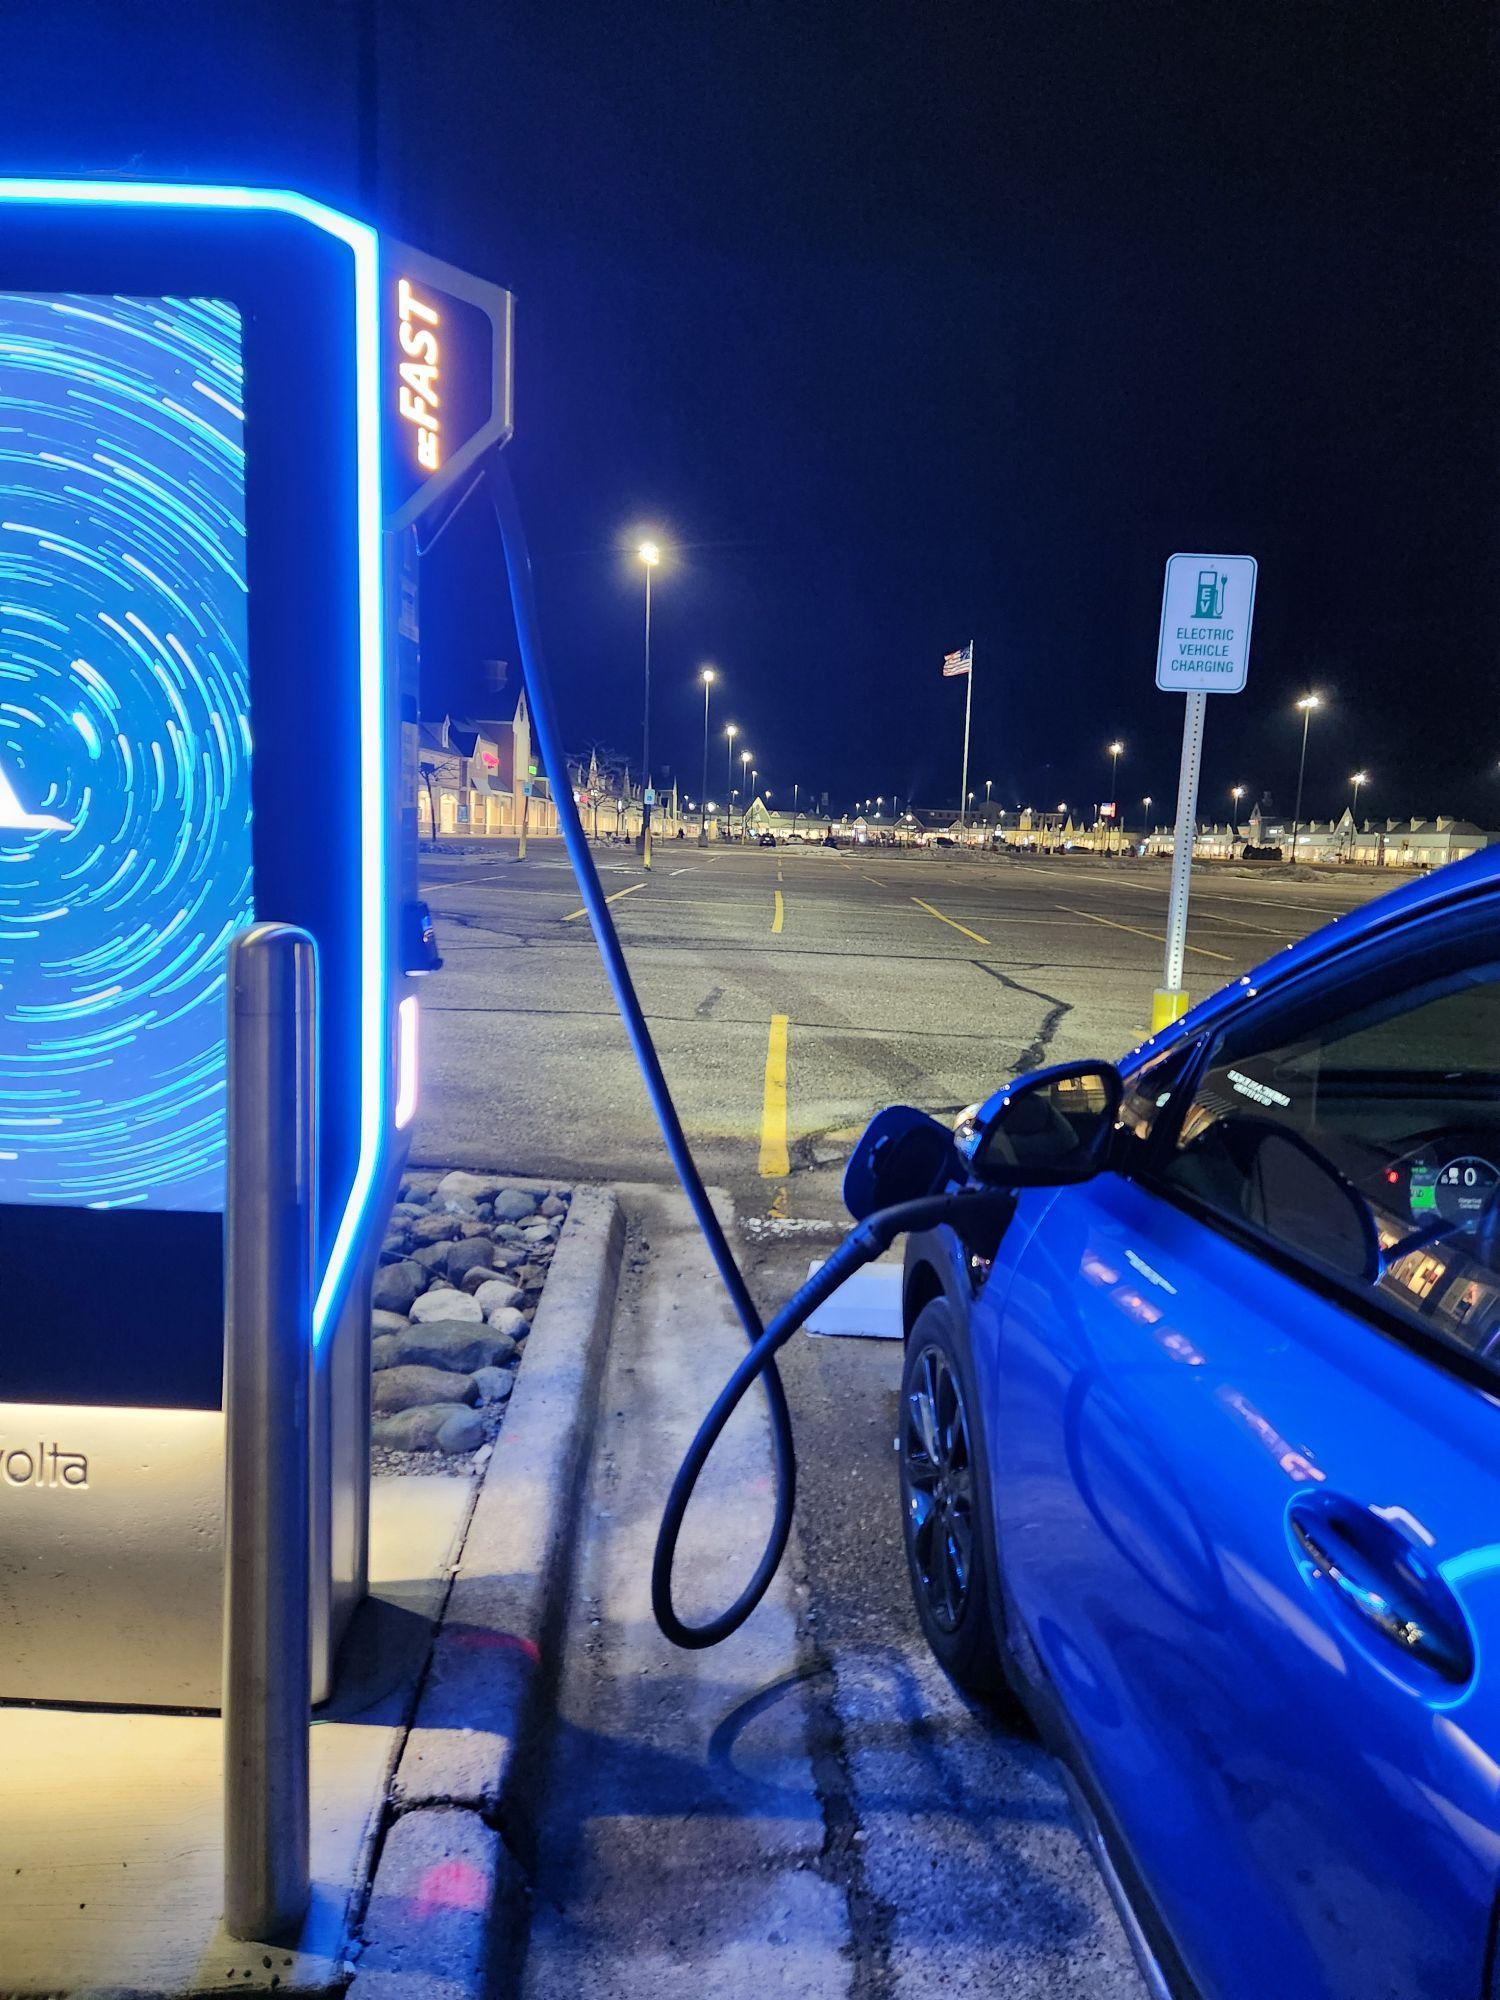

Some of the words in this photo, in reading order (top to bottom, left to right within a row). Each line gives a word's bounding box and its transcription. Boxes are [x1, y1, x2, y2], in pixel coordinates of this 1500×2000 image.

[1176, 627, 1235, 641] ELECTRIC
[1179, 643, 1230, 657] VEHICLE
[1171, 659, 1234, 673] CHARGING
[0, 1441, 88, 1485] olta
